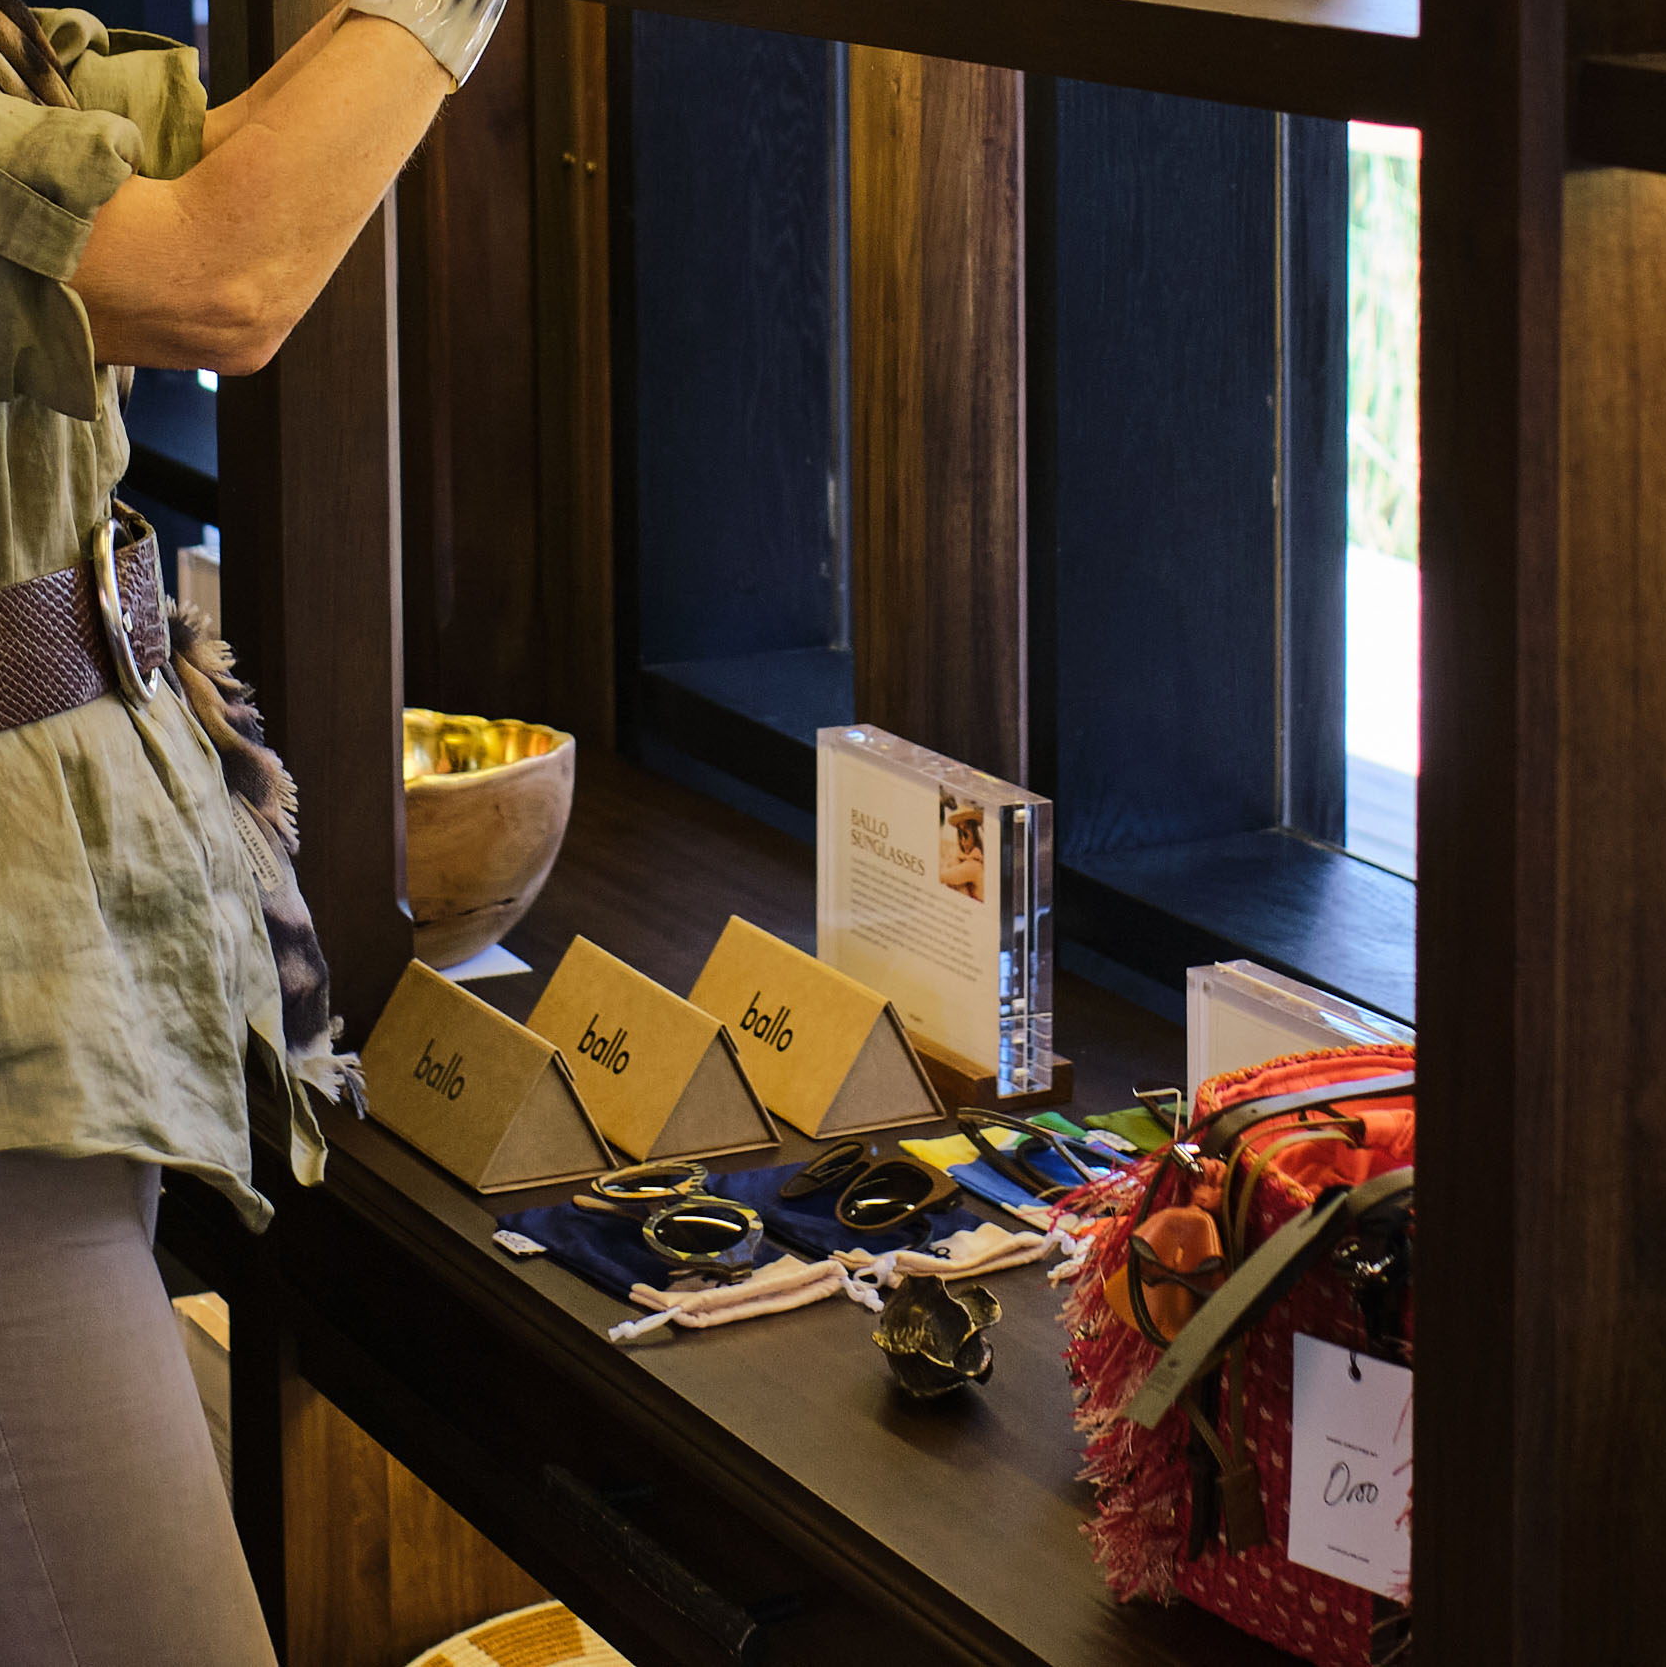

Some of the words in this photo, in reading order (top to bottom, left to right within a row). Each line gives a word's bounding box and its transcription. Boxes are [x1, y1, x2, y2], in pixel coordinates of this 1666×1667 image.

[851, 808, 888, 839] BALLO
[851, 829, 925, 876] SUNGLASSES
[576, 1014, 630, 1075] ballo
[739, 991, 794, 1053] ballo
[412, 1038, 465, 1101] ballo
